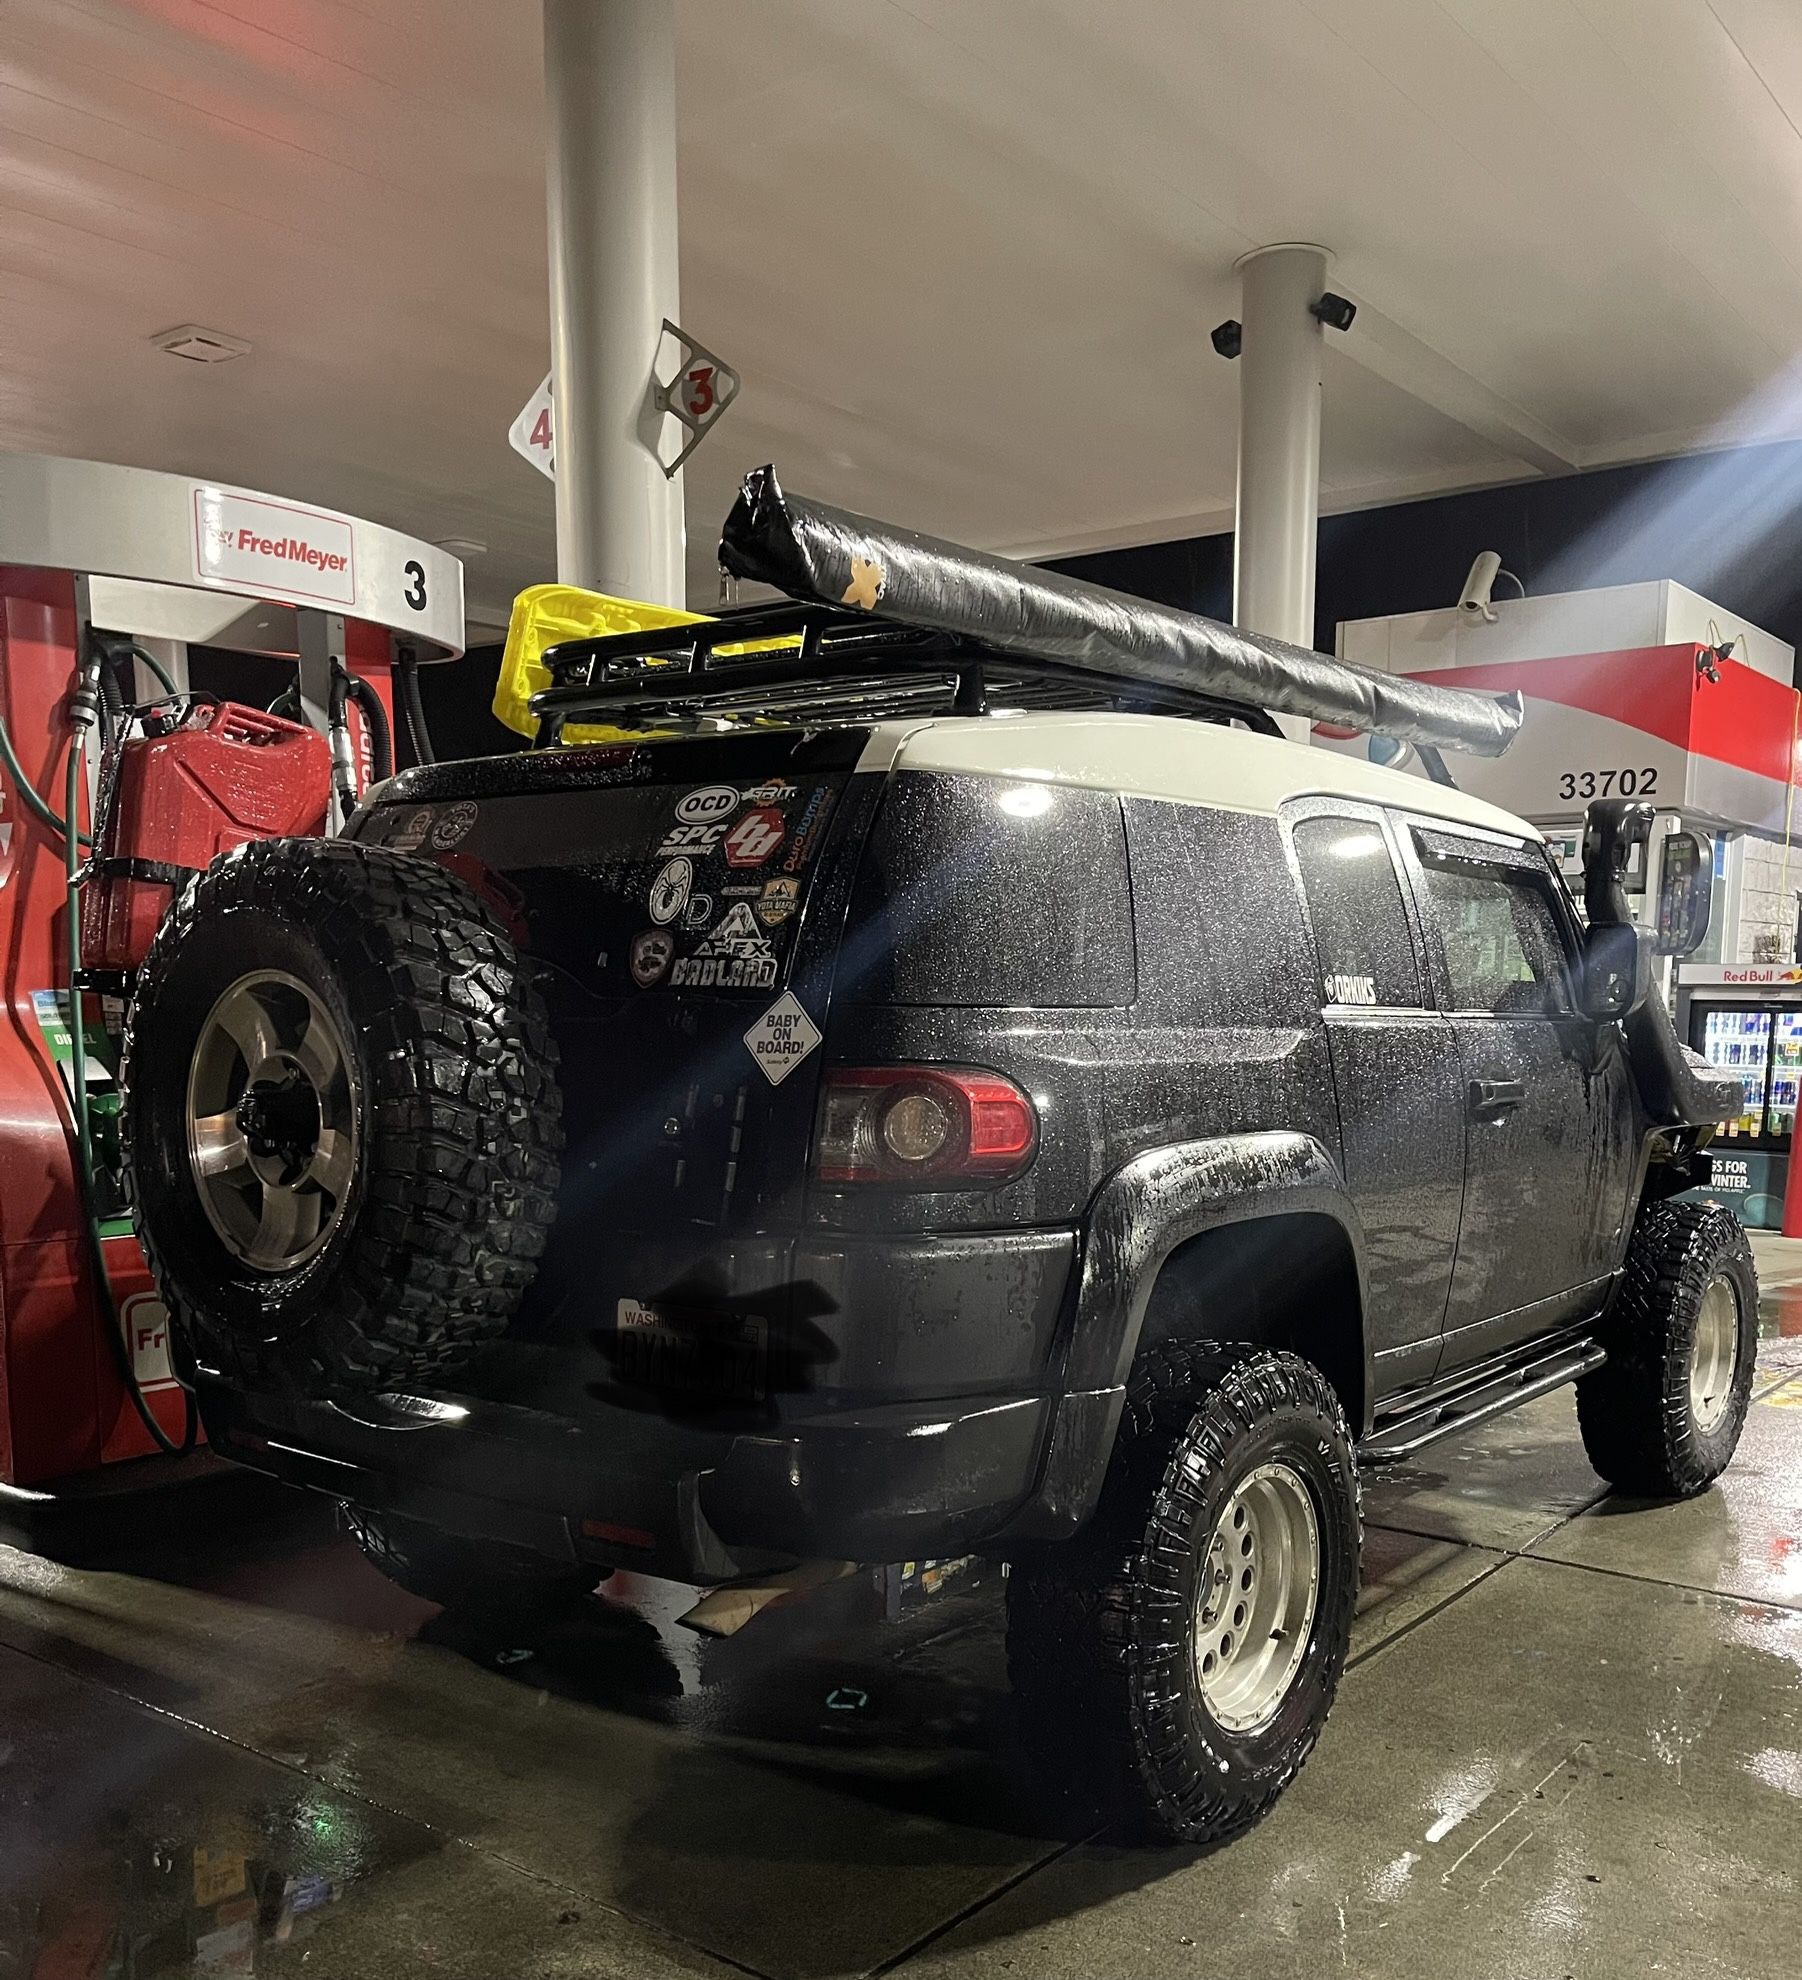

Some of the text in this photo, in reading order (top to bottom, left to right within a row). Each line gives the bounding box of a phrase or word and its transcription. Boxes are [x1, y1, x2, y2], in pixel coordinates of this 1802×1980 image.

[688, 366, 714, 415] 3
[529, 408, 554, 450] 4
[404, 560, 427, 611] 3
[1558, 767, 1659, 801] 33702
[684, 794, 732, 812] OCD
[663, 824, 729, 845] SPC
[1723, 970, 1773, 982] Red Bull
[766, 1014, 802, 1028] BABY
[773, 1027, 792, 1041] ON
[756, 1041, 805, 1055] BOARD!
[1725, 1160, 1747, 1174] FOR
